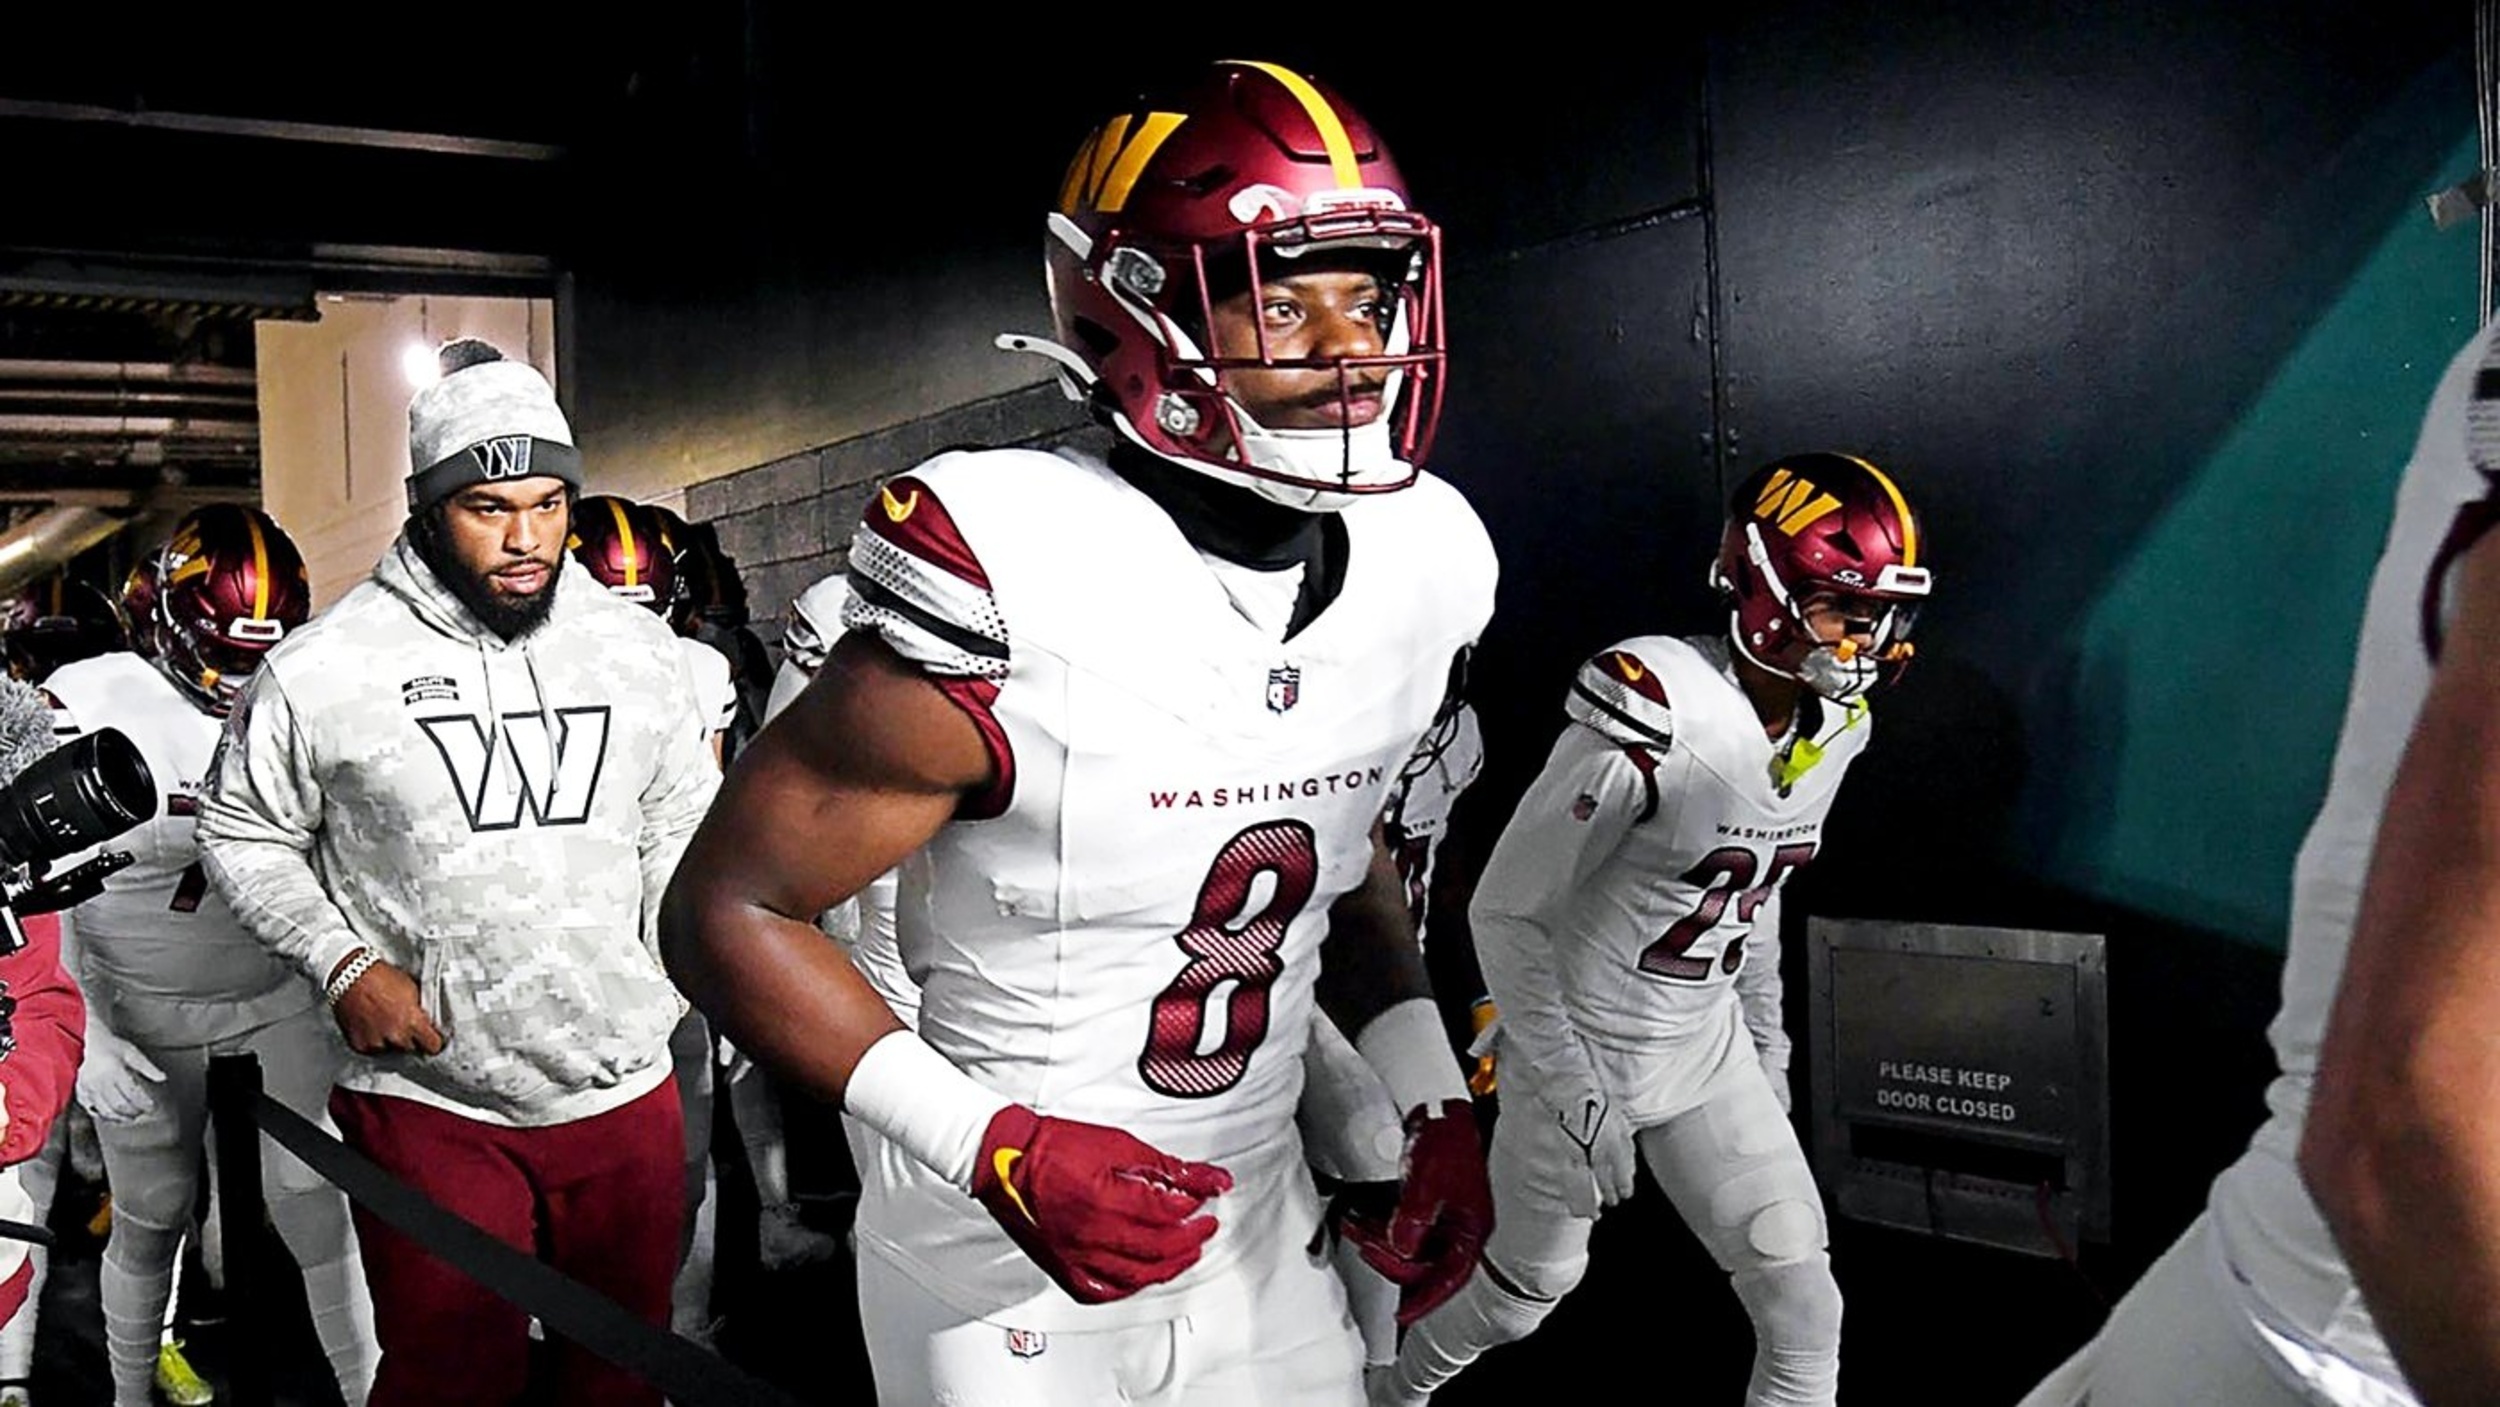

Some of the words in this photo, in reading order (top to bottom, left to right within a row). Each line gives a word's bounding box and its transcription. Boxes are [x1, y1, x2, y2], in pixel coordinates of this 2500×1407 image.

[470, 435, 532, 479] W
[415, 706, 611, 832] W
[1150, 766, 1384, 808] WASHINGTON
[1716, 823, 1817, 841] WASHINGTON
[1138, 818, 1318, 1098] 8
[1879, 1061, 1952, 1086] PLEASE
[1957, 1069, 2012, 1091] KEEP
[1877, 1089, 1932, 1111] DOOR
[1936, 1096, 2016, 1121] CLOSED
